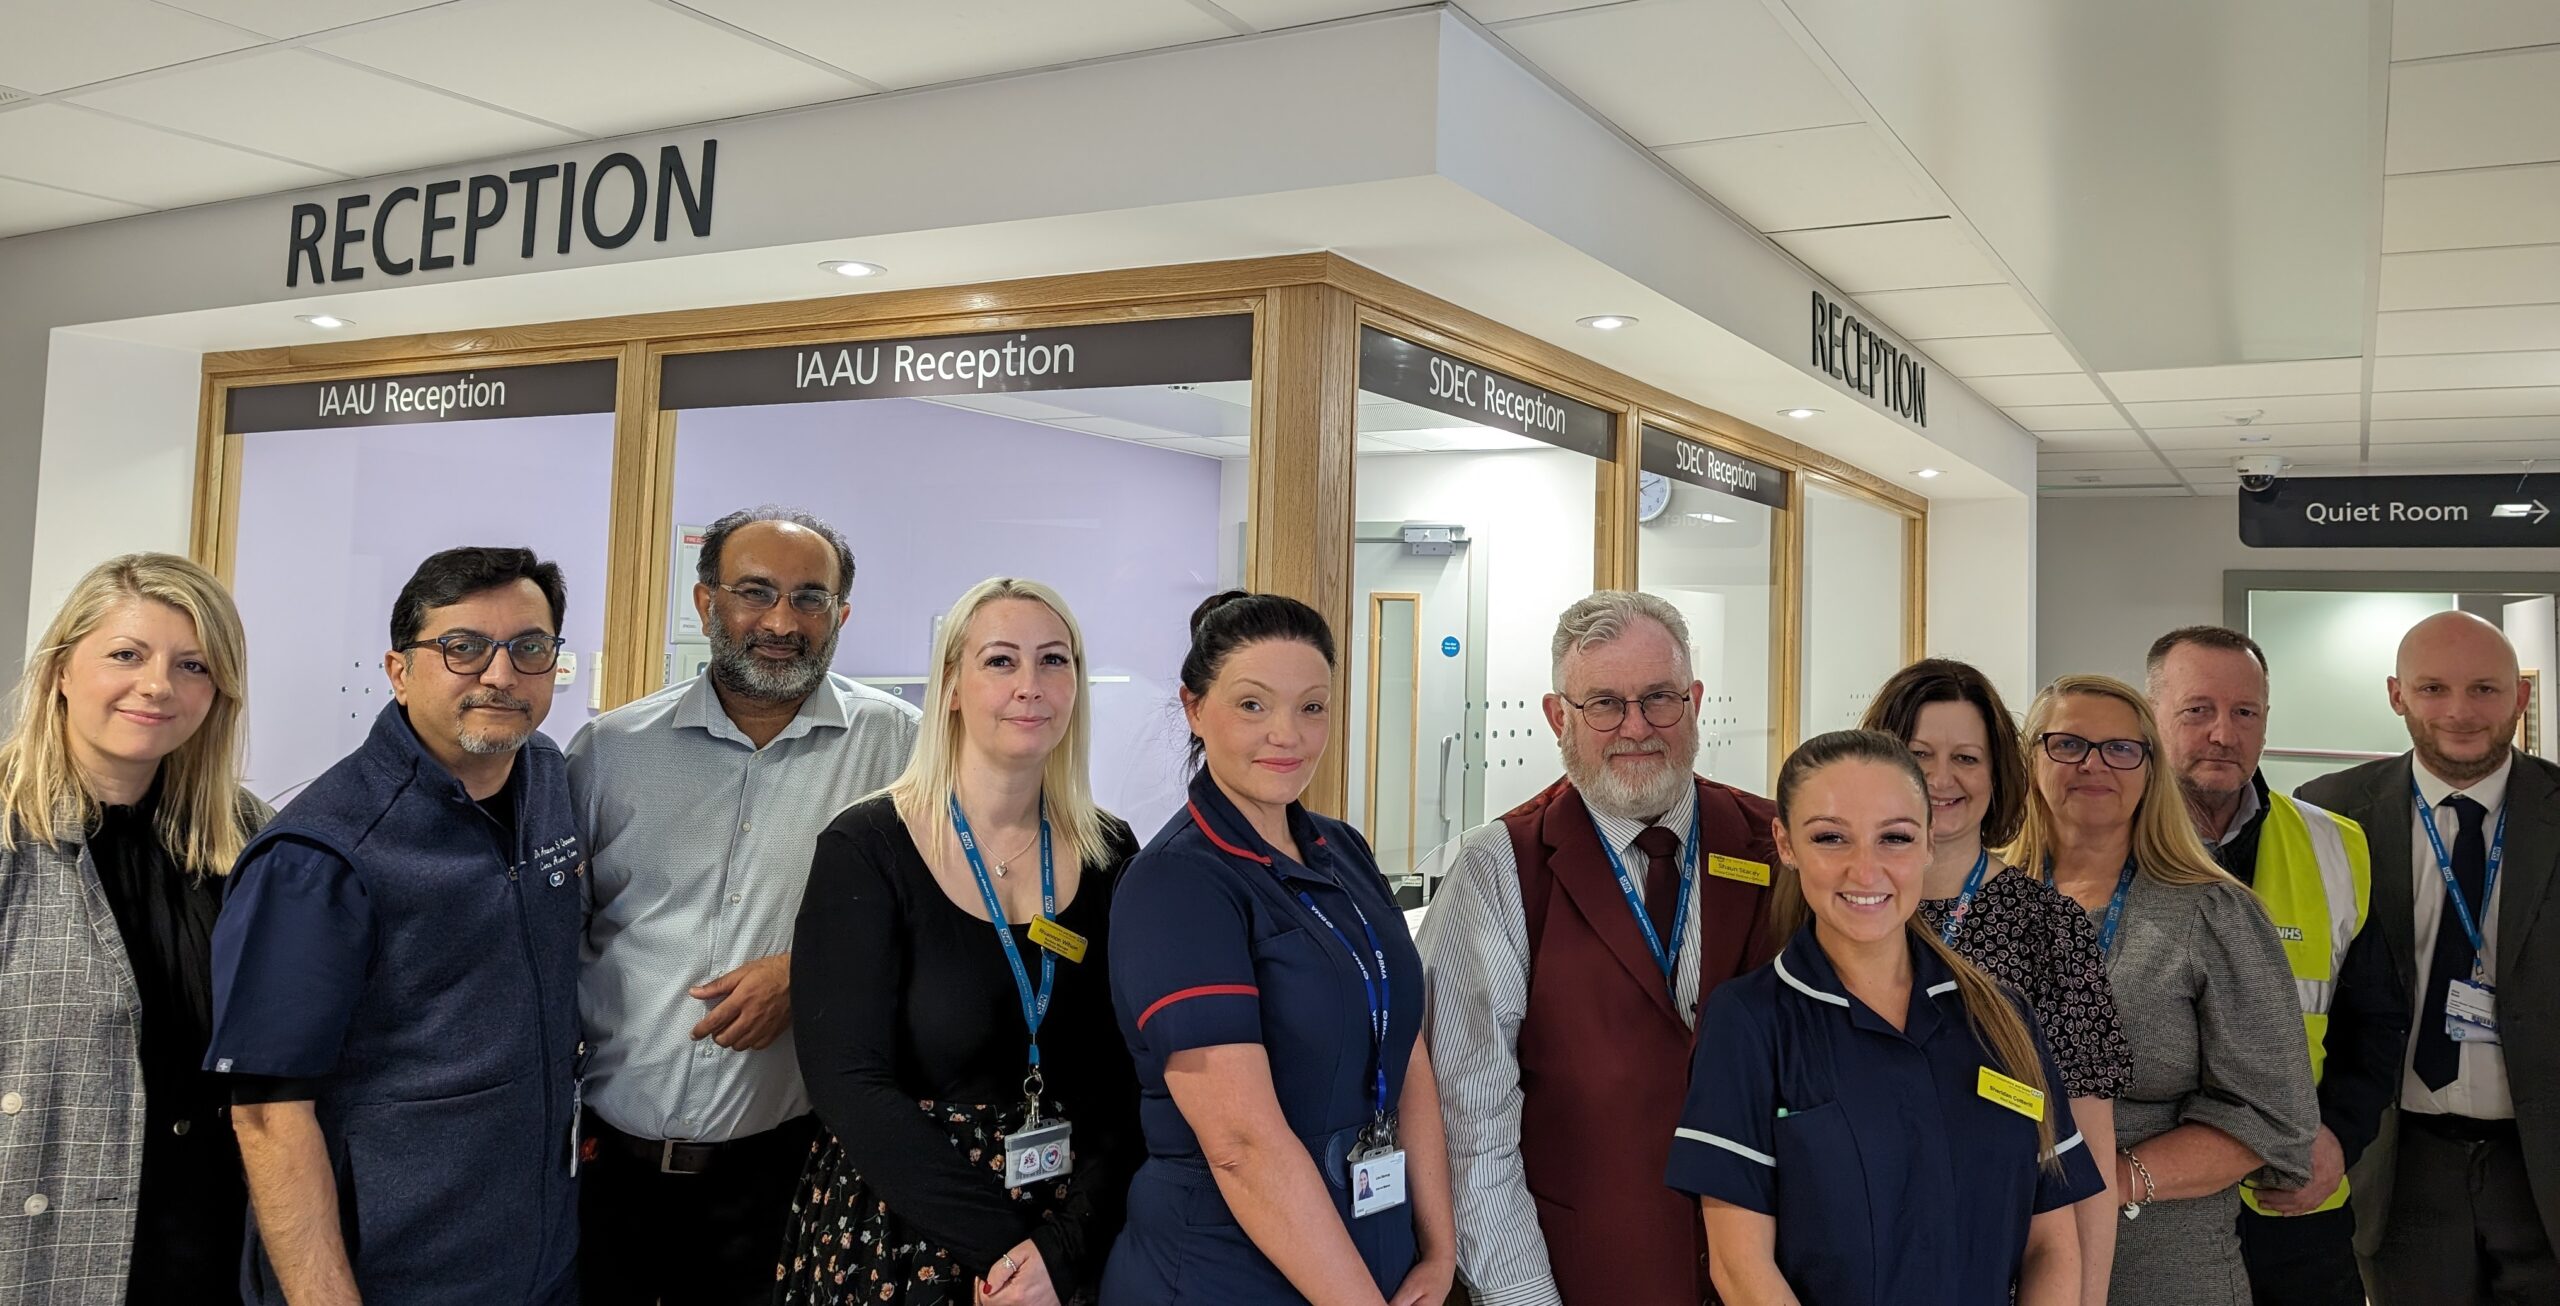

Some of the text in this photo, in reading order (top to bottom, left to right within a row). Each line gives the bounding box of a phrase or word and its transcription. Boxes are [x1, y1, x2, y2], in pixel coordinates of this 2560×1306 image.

[286, 139, 717, 287] RECEPTION
[795, 334, 1076, 389] IAAU Reception
[1811, 290, 1927, 428] RECEPTION
[318, 373, 506, 418] IAAU Reception
[1429, 356, 1566, 435] SDEC Reception
[1675, 440, 1757, 494] SDEC Reception
[2305, 501, 2469, 525] Quiet Room
[960, 831, 974, 850] NHS
[1619, 875, 1633, 894] NHS
[1044, 895, 1054, 913] NHS
[1000, 928, 1012, 947] NHS
[2276, 927, 2302, 940] NHS
[1378, 959, 1387, 979] BMA
